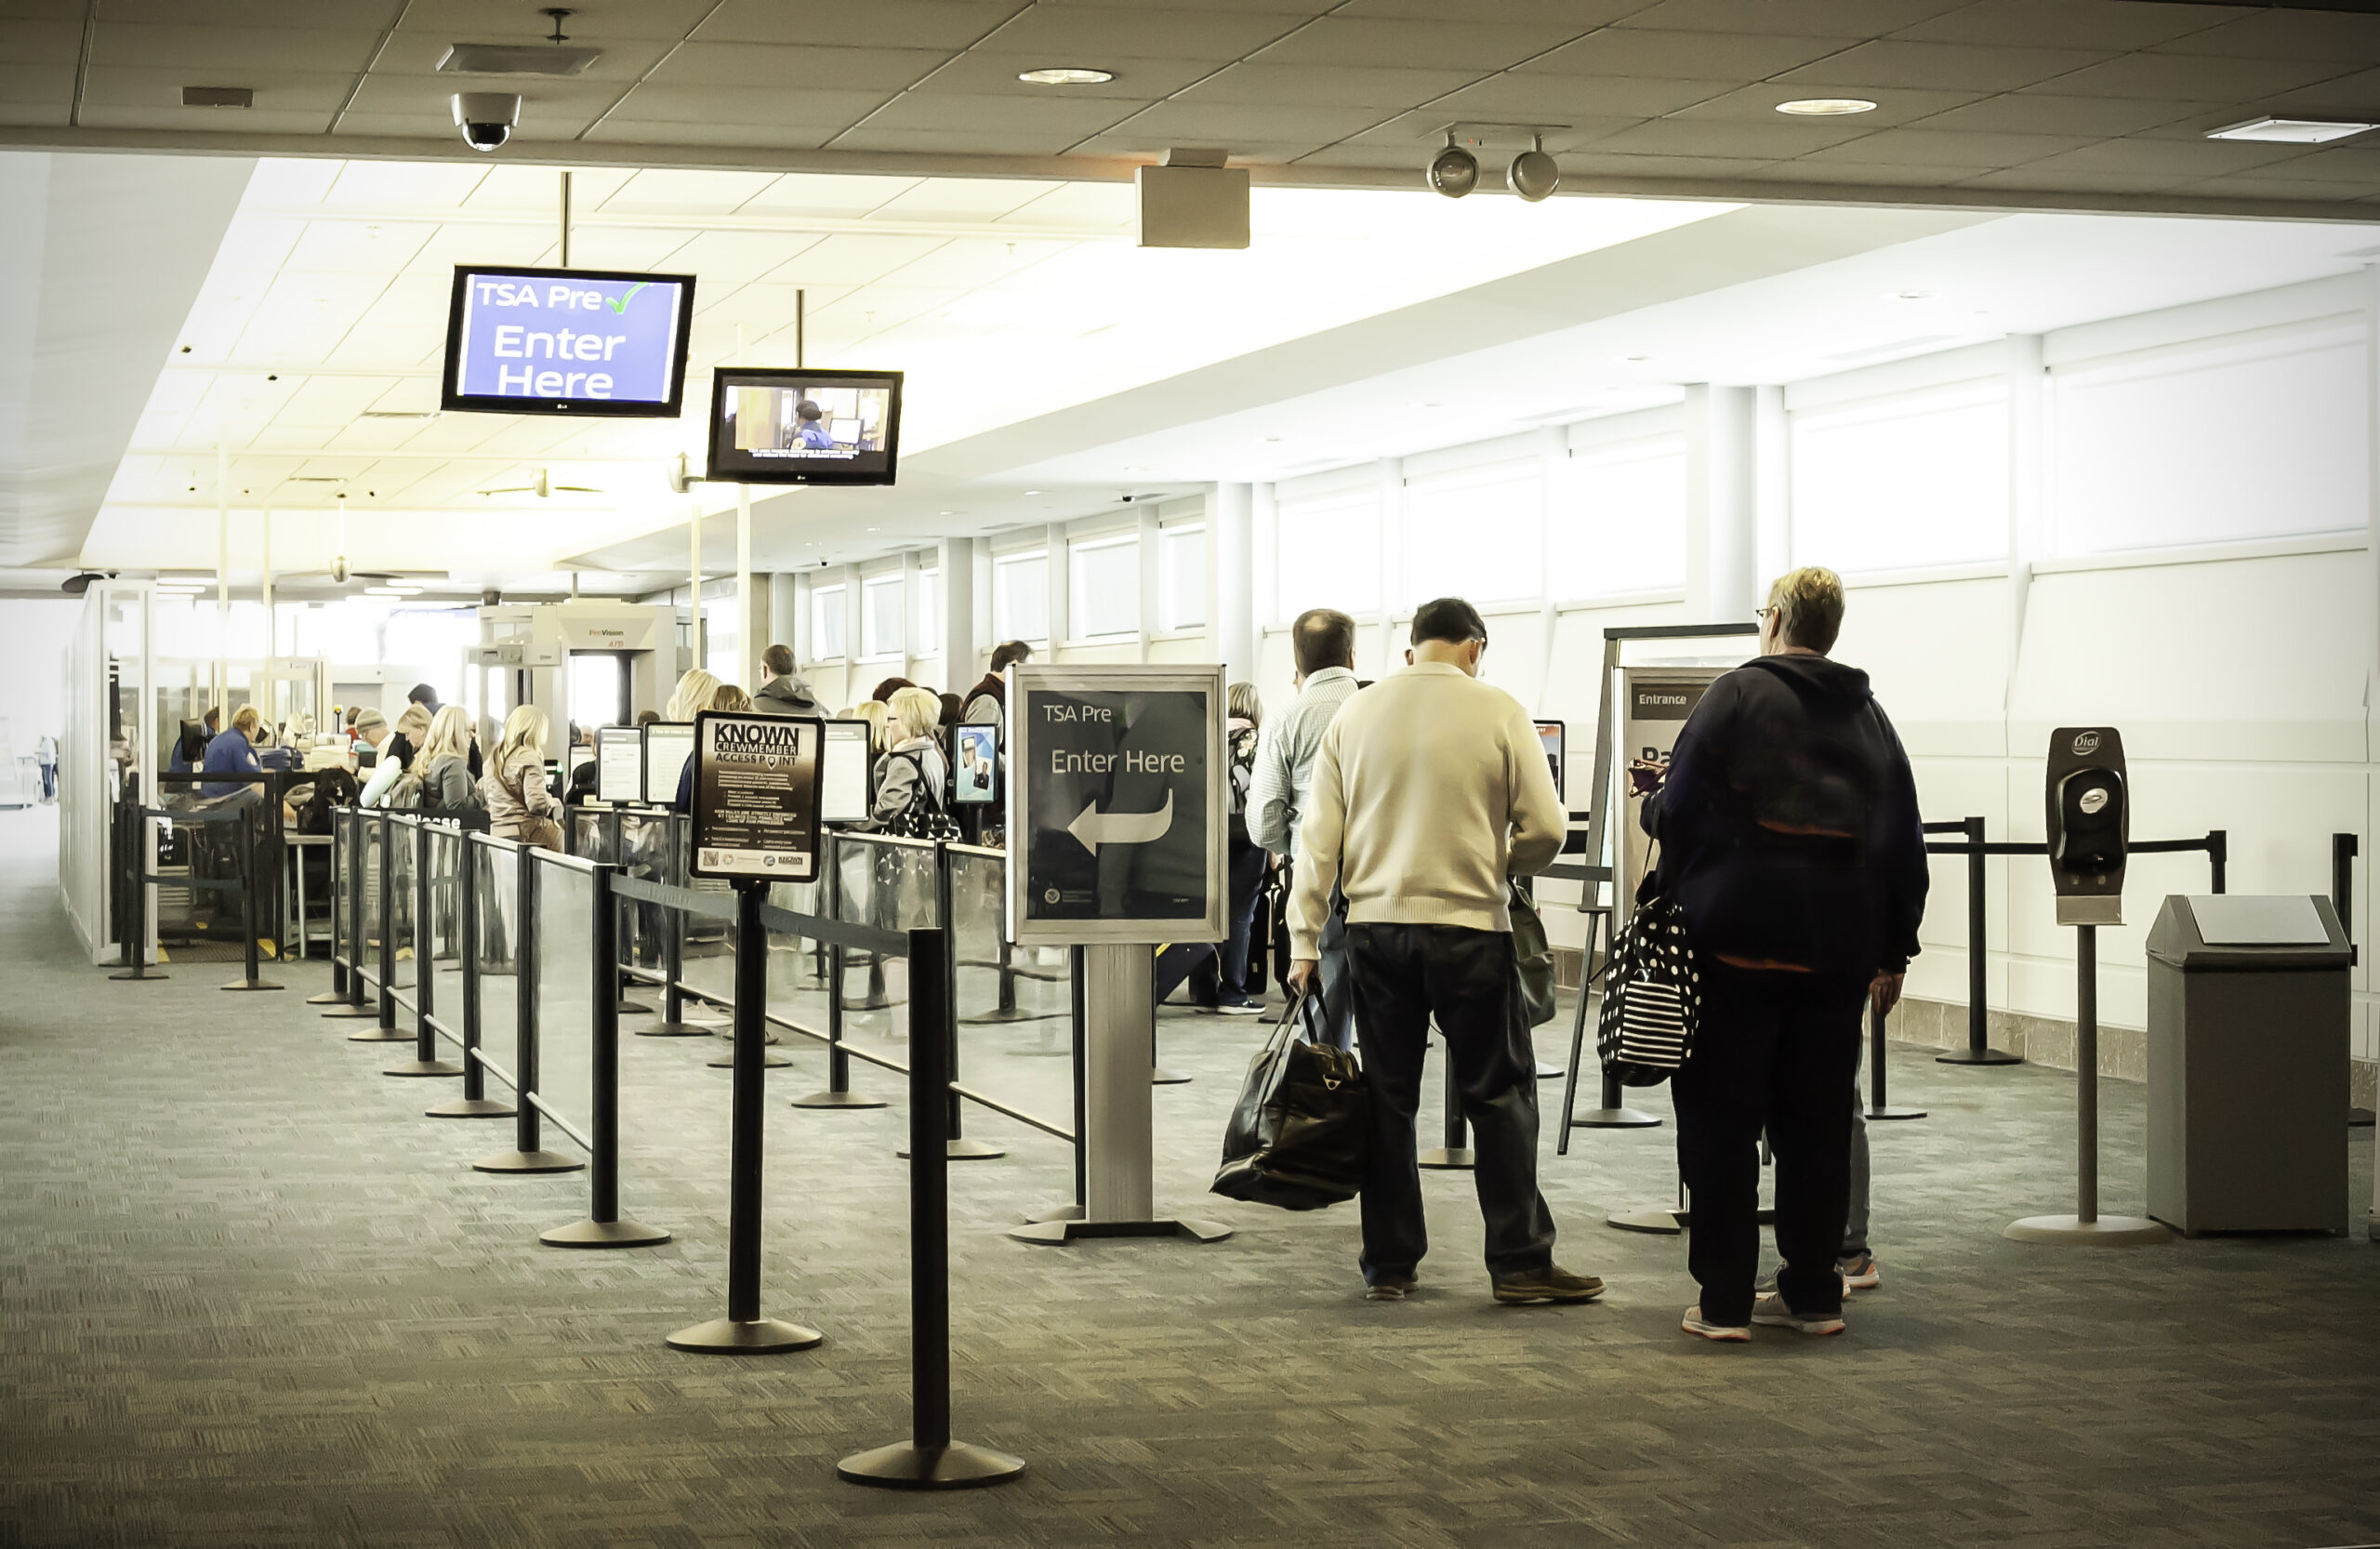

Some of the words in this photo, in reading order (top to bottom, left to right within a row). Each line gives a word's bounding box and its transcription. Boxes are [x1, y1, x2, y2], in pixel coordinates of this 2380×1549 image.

[476, 282, 538, 308] TSA
[548, 285, 602, 311] Pre
[494, 324, 627, 362] Enter
[497, 364, 614, 400] Here
[1639, 694, 1687, 705] Entrance
[1043, 705, 1078, 722] TSA
[1082, 705, 1112, 722] Pre
[714, 722, 800, 746] KNOWN
[2074, 736, 2099, 747] Dial
[715, 742, 797, 756] CREWMEMBER
[715, 752, 757, 763] ACCESS
[1051, 748, 1117, 774] Enter
[1126, 749, 1185, 774] Here
